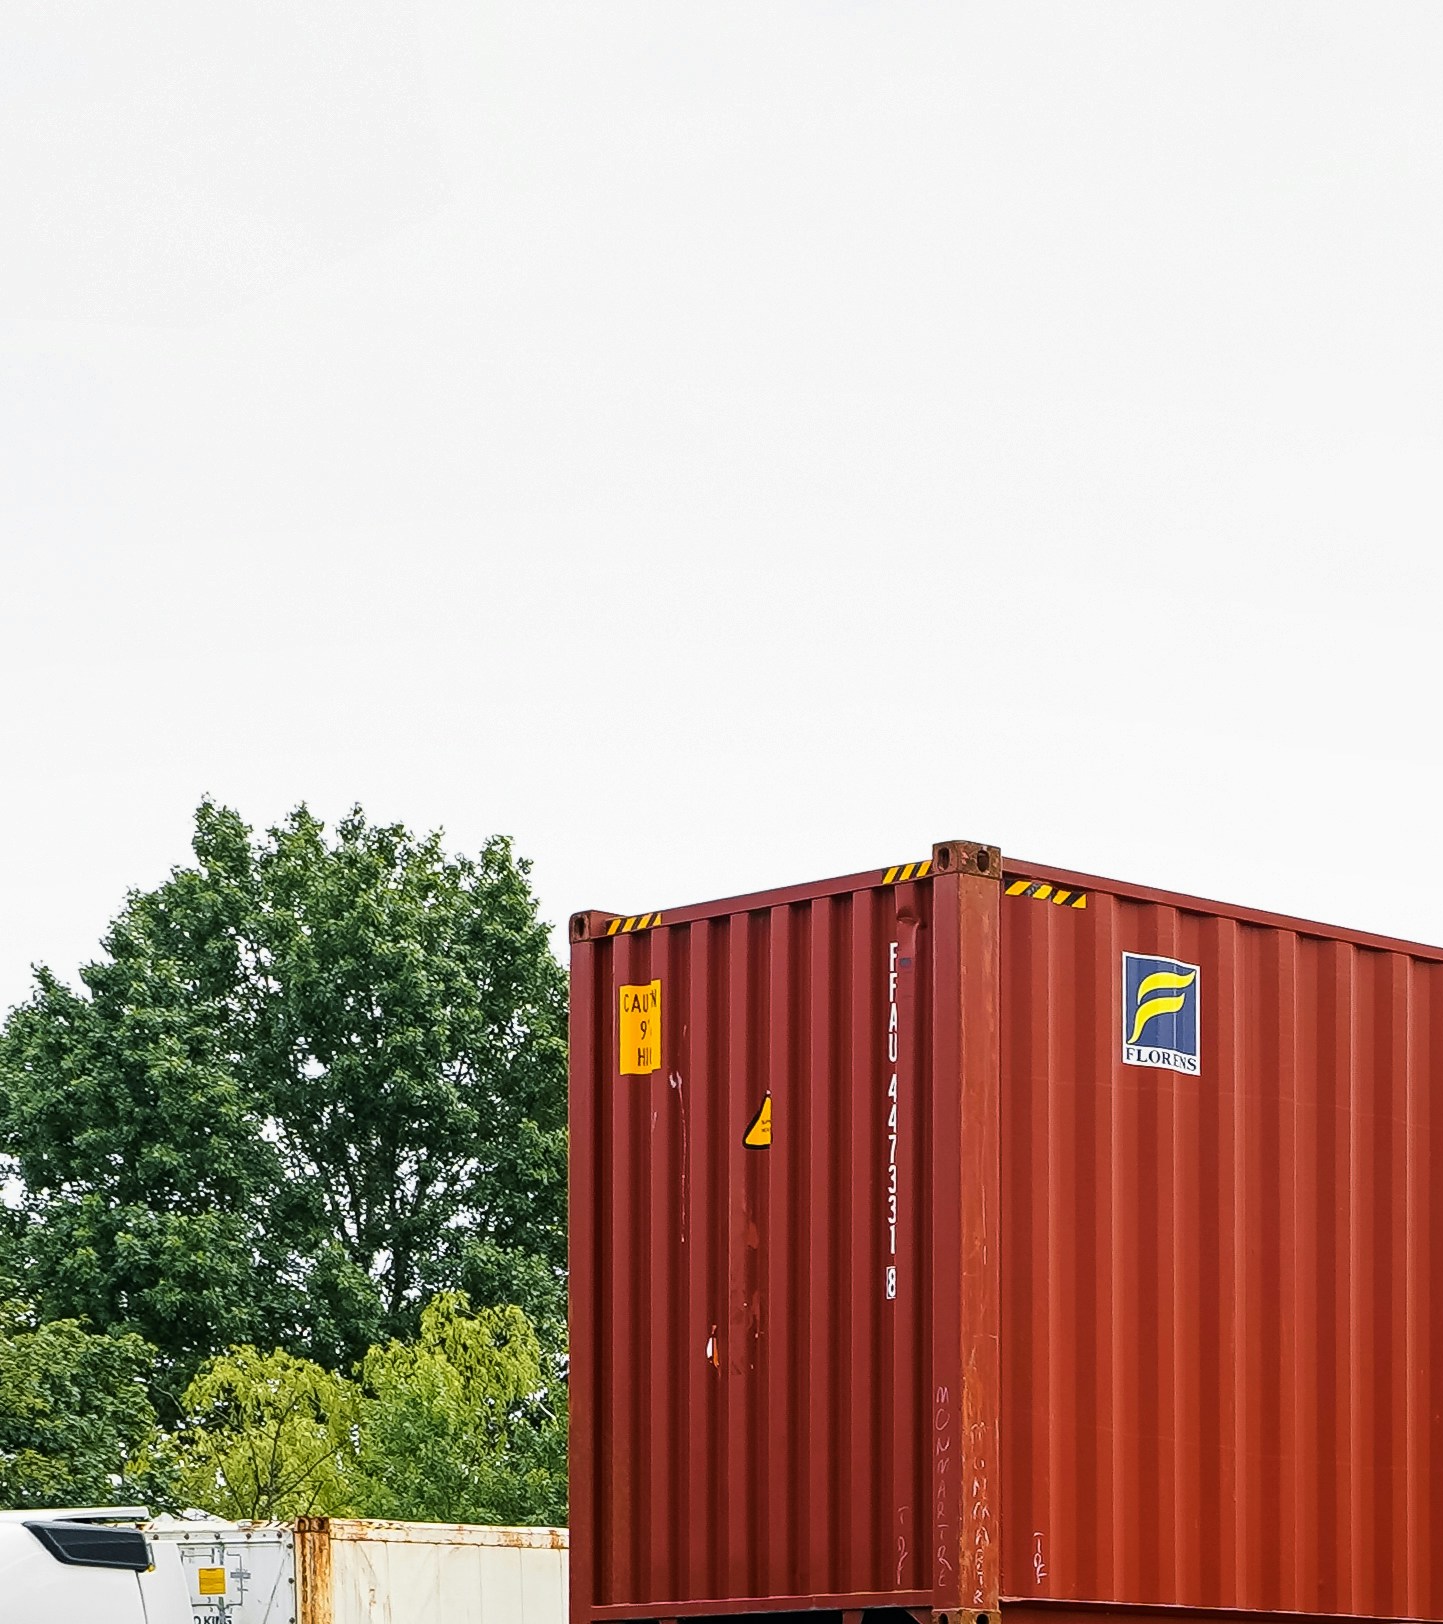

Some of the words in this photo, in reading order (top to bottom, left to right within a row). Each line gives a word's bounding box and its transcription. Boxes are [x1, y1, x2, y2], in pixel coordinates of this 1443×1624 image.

[888, 942, 899, 1062] FFAU
[1126, 1047, 1197, 1071] FLORENS
[887, 1073, 898, 1254] 447331
[886, 1266, 897, 1299] 8
